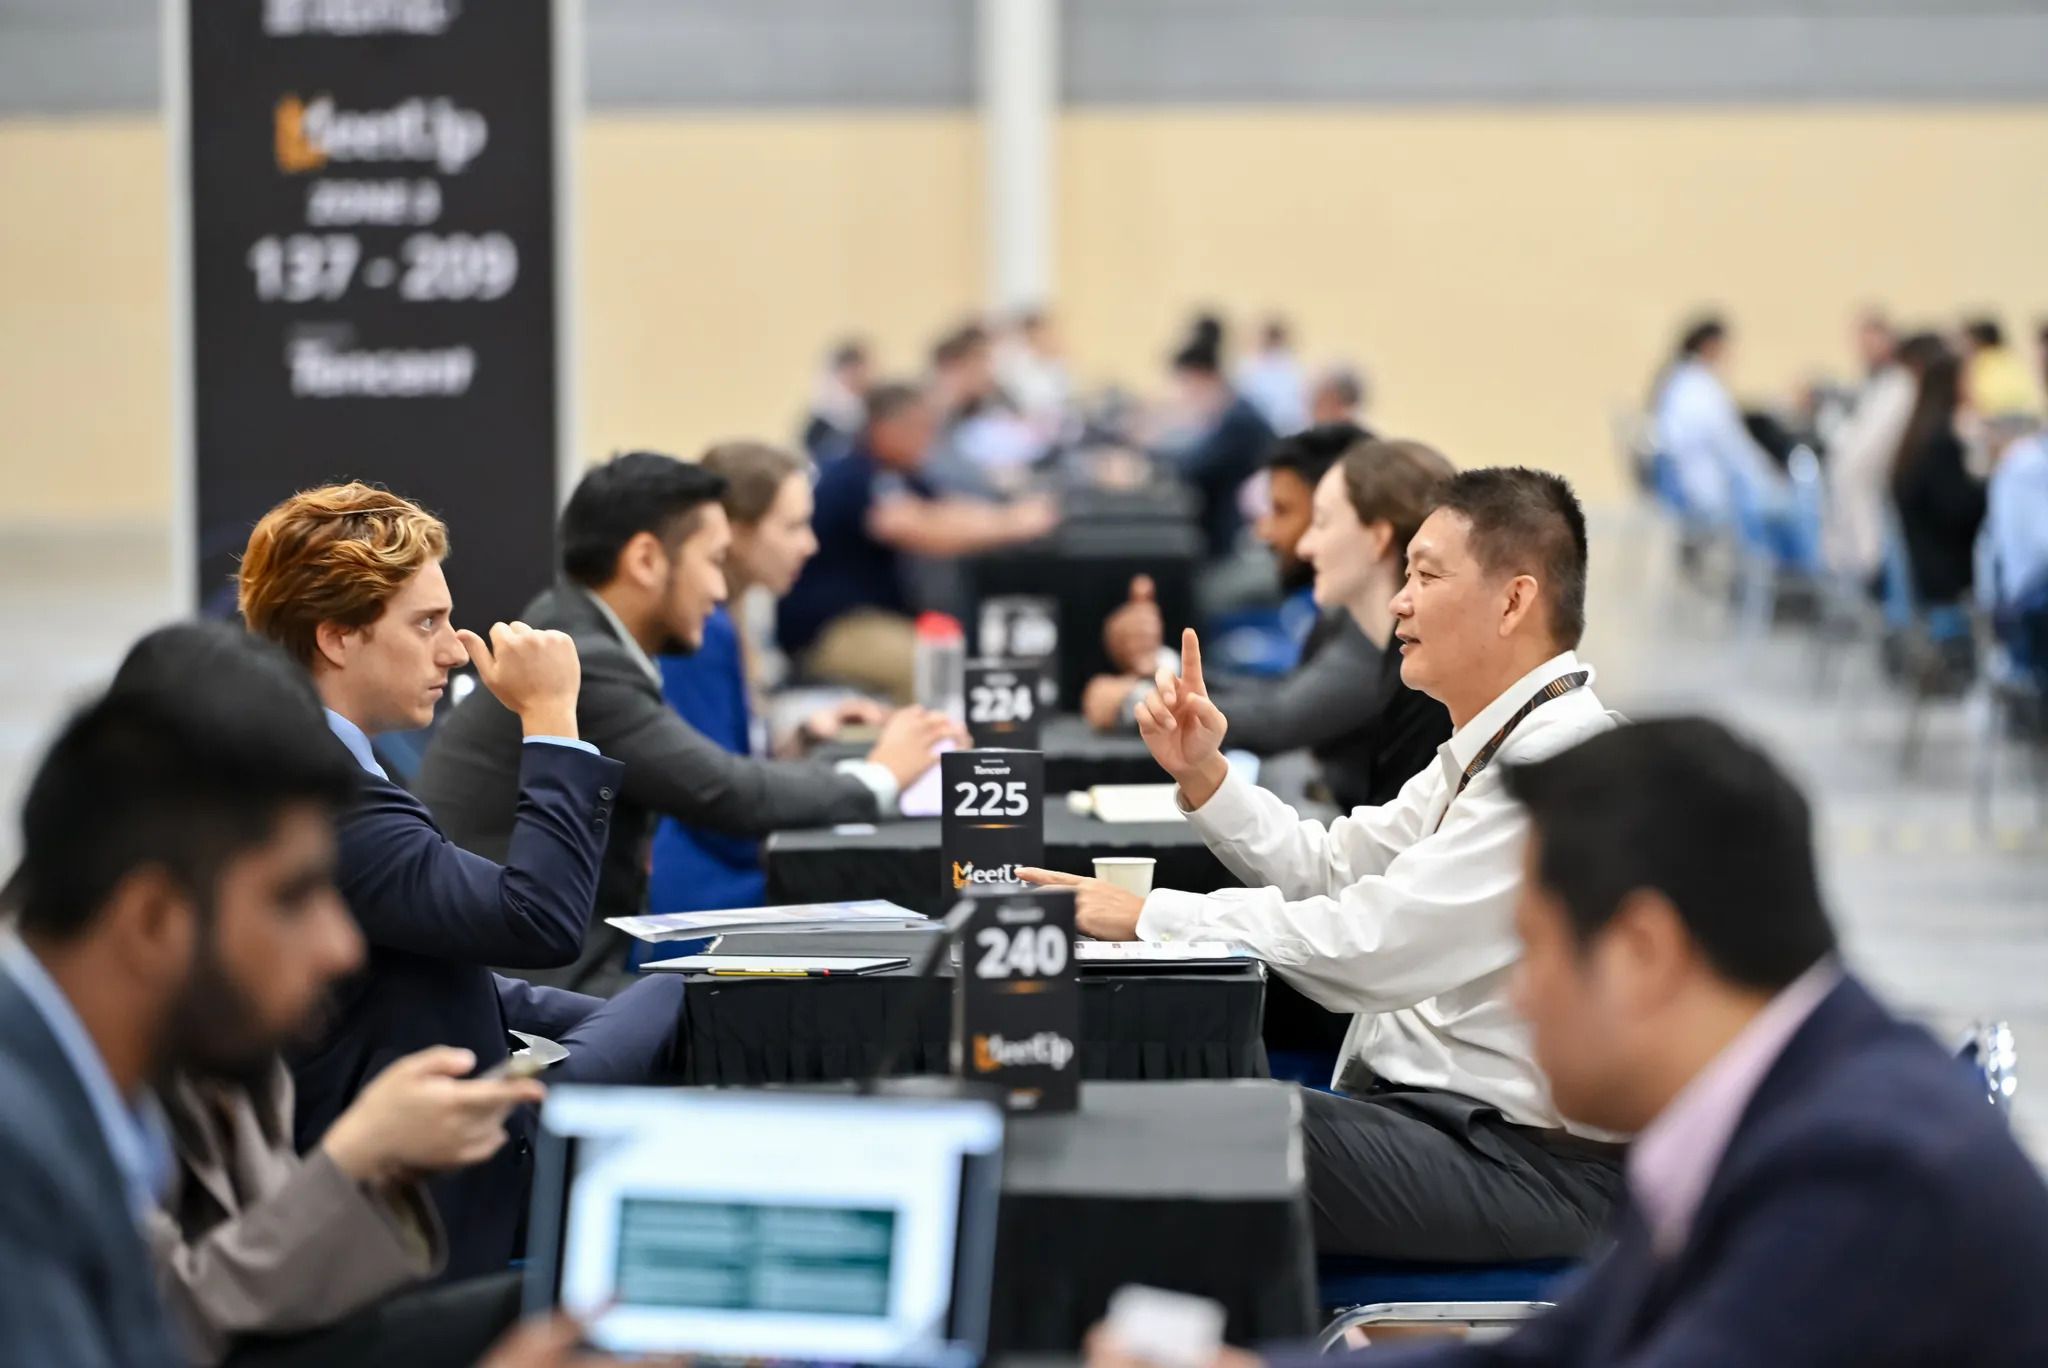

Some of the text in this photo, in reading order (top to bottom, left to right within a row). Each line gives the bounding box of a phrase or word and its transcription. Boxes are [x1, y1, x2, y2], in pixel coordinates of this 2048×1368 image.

[251, 235, 360, 301] 137
[970, 686, 1033, 722] 224
[973, 764, 1011, 775] Tencent
[954, 781, 1029, 816] 225
[976, 925, 1067, 978] 240
